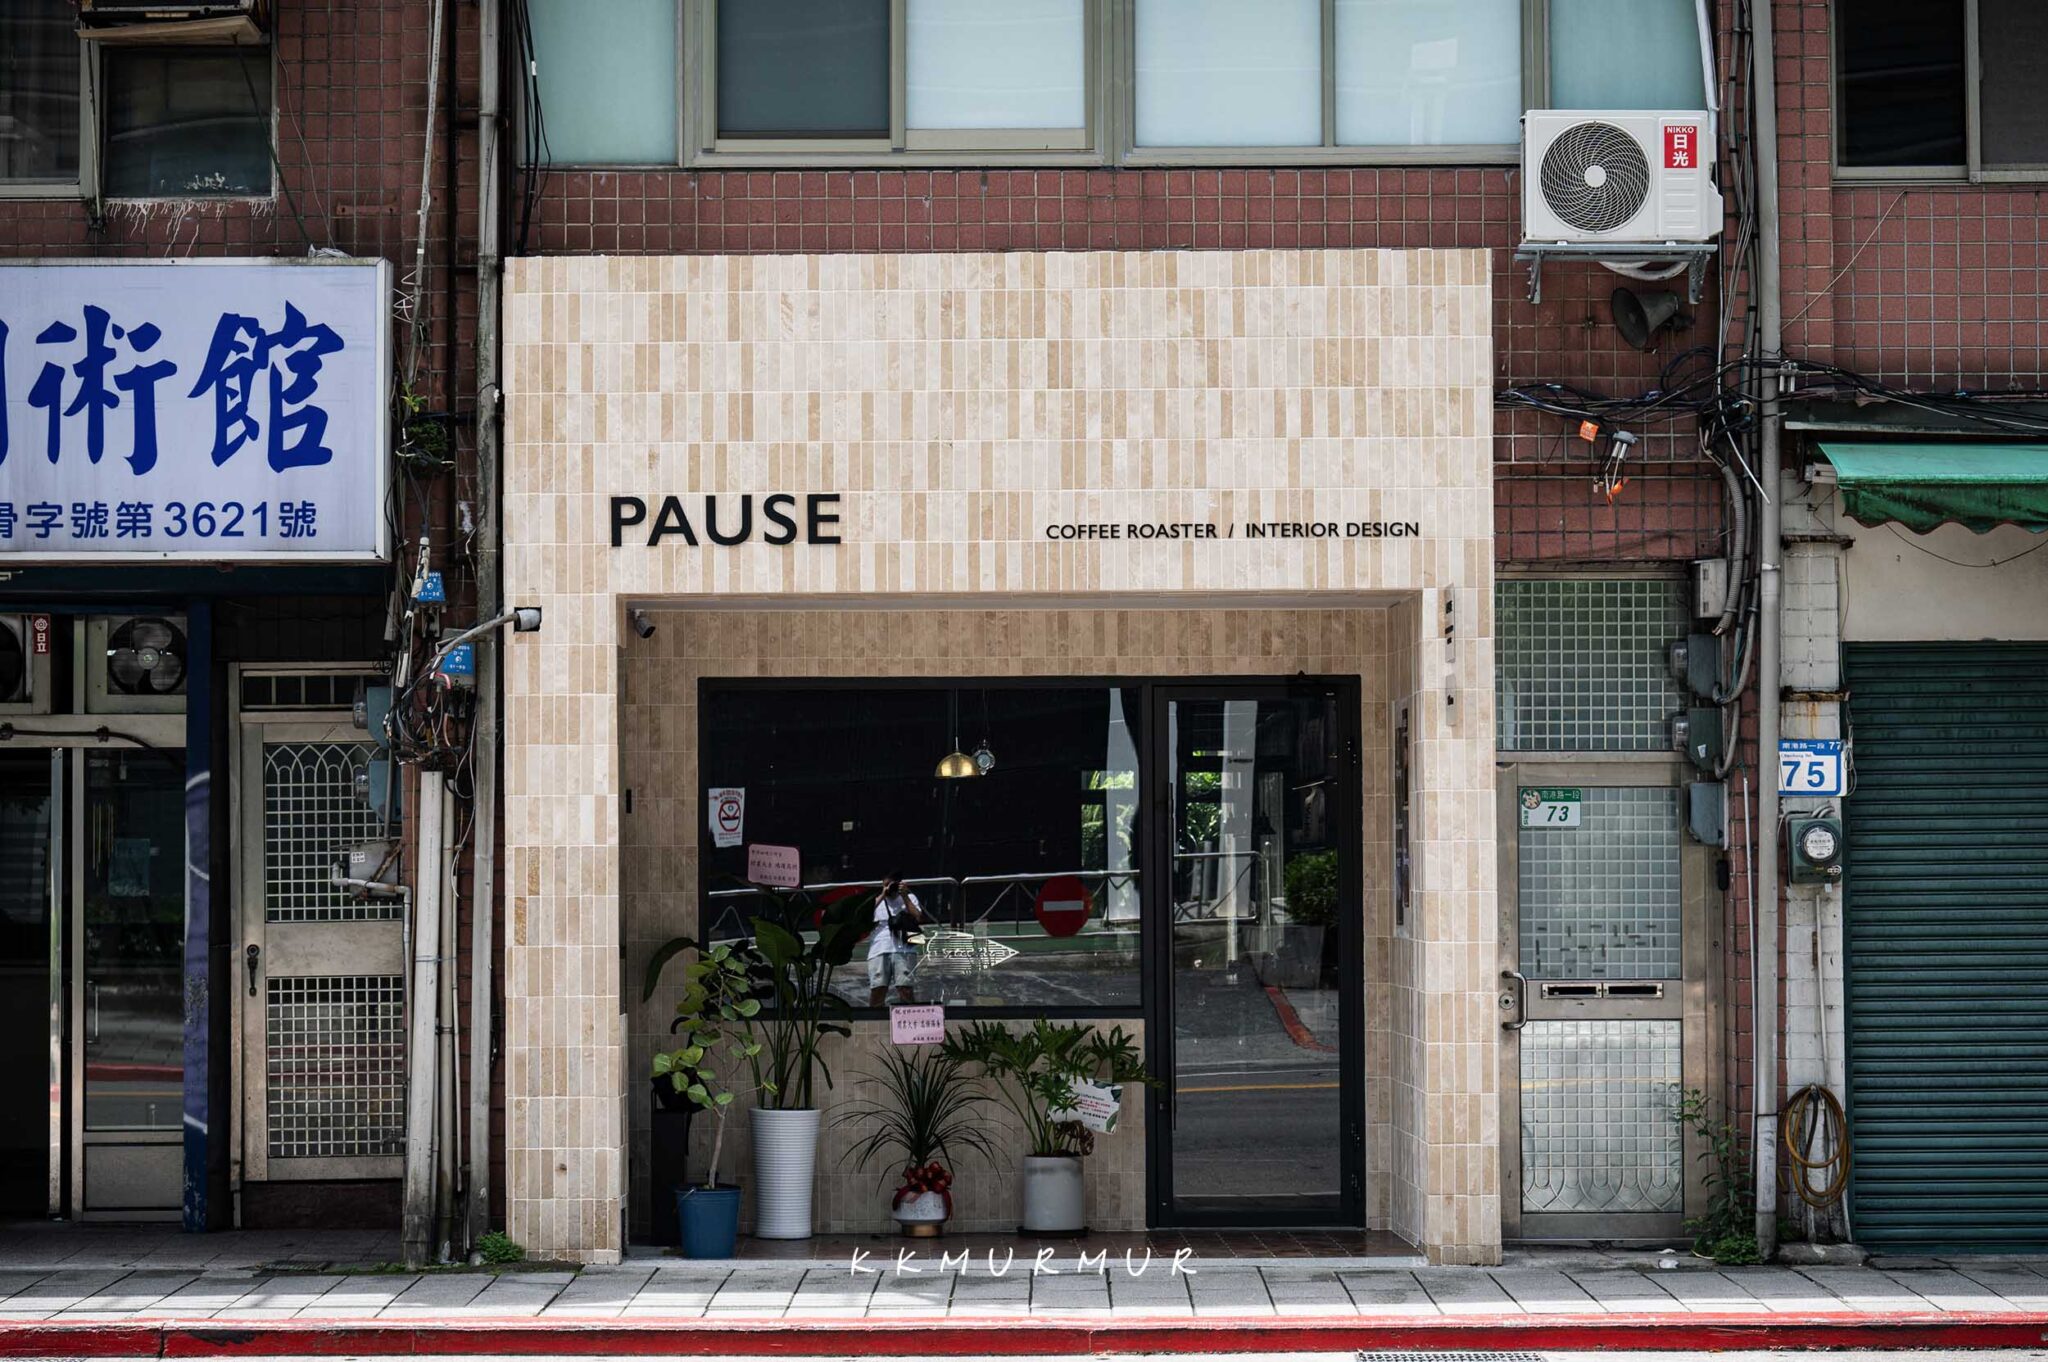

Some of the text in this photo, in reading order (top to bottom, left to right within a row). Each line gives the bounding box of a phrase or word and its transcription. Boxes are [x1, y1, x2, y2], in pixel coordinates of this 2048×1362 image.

[1672, 134, 1689, 167] 日光
[0, 301, 345, 476] 術館
[610, 493, 841, 547] PAUSE
[1046, 524, 1120, 540] COFFEE
[1127, 523, 1217, 539] ROASTER
[1246, 522, 1340, 538] INTERIOR
[1346, 521, 1419, 538] DESIGN
[37, 633, 46, 653] 日立
[1782, 761, 1825, 788] 75
[1541, 790, 1580, 799] 南港路一段
[1547, 805, 1569, 822] 73
